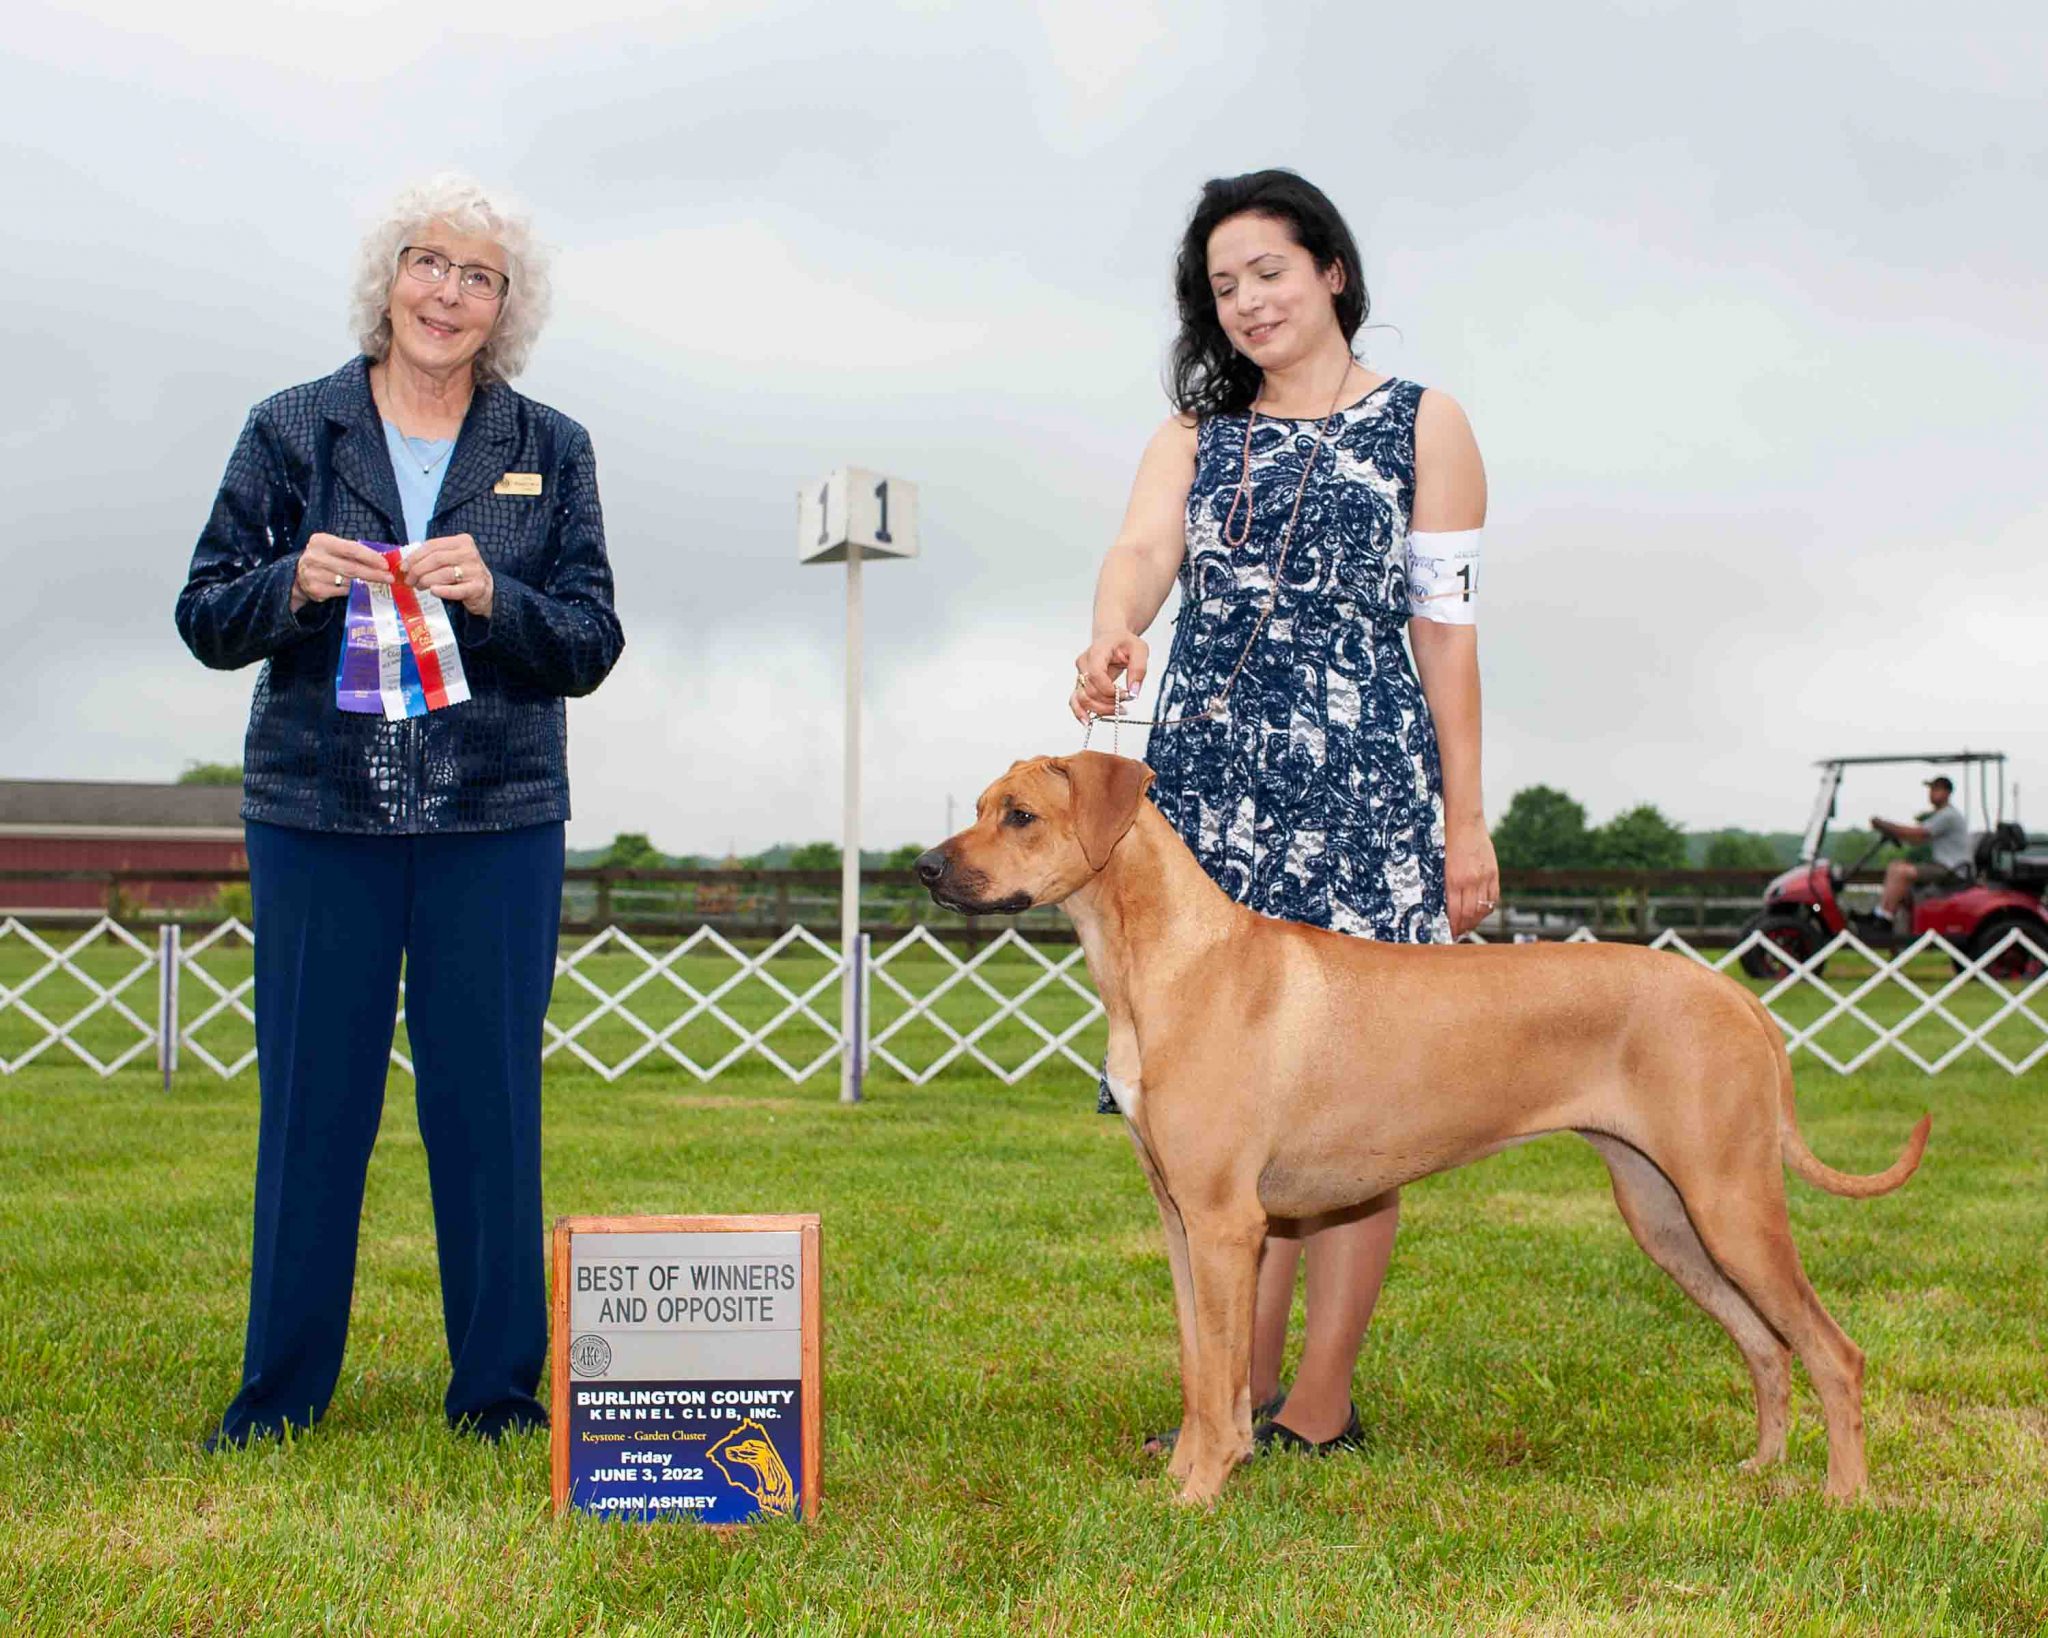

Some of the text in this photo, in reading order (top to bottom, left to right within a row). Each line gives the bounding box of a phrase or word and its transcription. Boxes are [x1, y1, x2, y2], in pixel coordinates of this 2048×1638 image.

[875, 479, 892, 543] 1
[1456, 564, 1470, 602] 1
[577, 1264, 795, 1291] BEST OF WINNERS
[598, 1297, 774, 1323] AND OPPOSITE
[580, 1346, 600, 1366] AKC
[577, 1390, 794, 1405] BURLINGTON COUNTY
[589, 1408, 781, 1421] KENNEL CLUB, INC.
[582, 1431, 626, 1443] Keystone
[634, 1430, 670, 1441] Garden
[671, 1429, 707, 1441] Cluster
[621, 1451, 672, 1466] Friday
[590, 1468, 703, 1483] JUNE 3, 2022
[598, 1496, 717, 1510] JOHN ASHBEY
